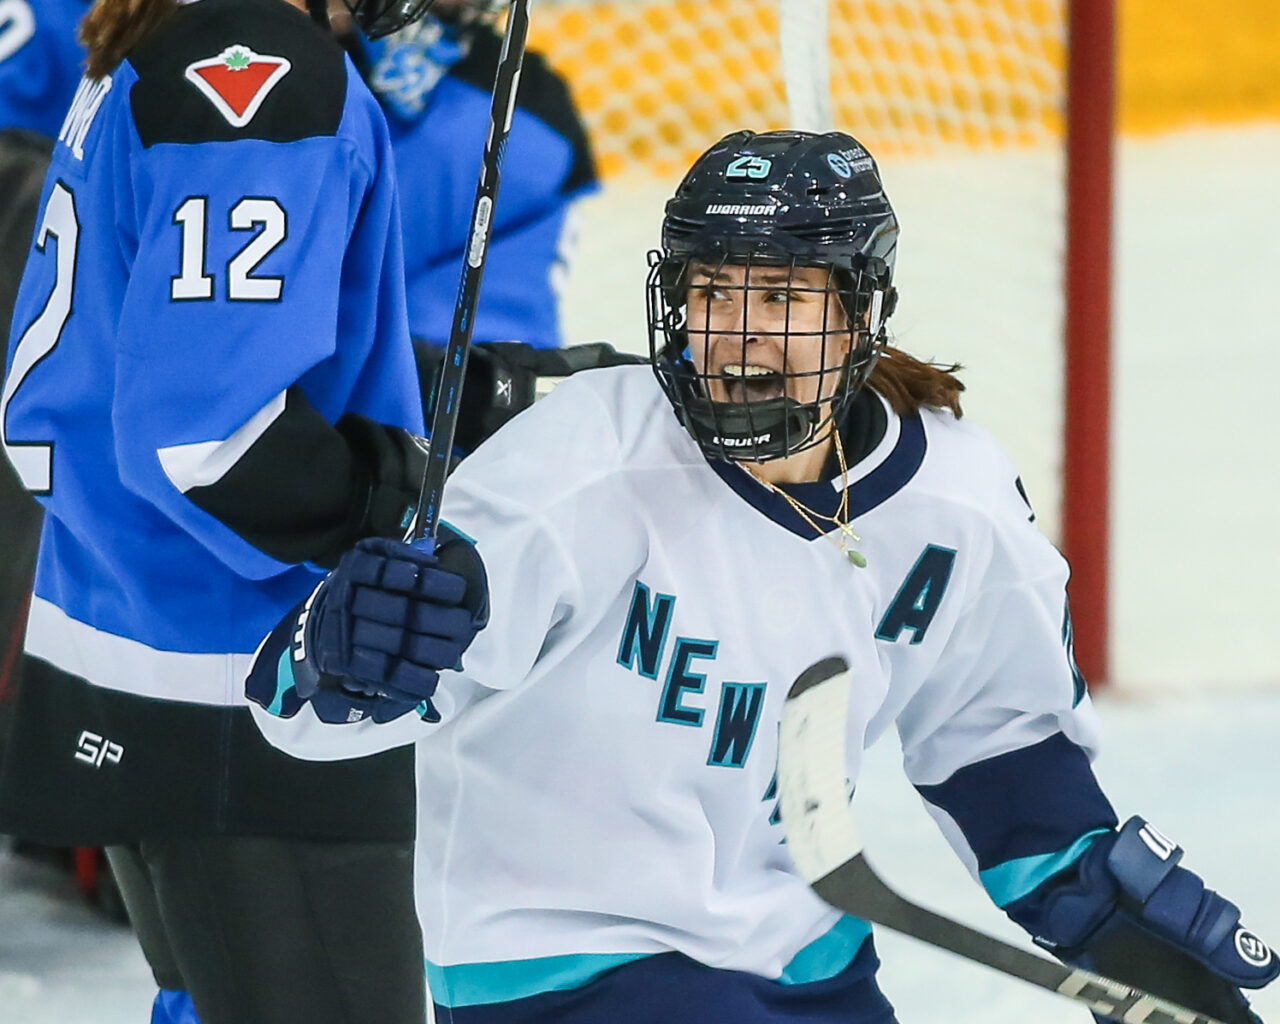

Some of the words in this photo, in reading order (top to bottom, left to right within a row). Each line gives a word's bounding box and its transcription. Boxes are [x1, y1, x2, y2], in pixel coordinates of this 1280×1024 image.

[705, 204, 776, 216] WARRIOR
[726, 155, 773, 179] 25
[170, 195, 287, 302] 12
[874, 543, 958, 645] A
[616, 579, 767, 769] NEW
